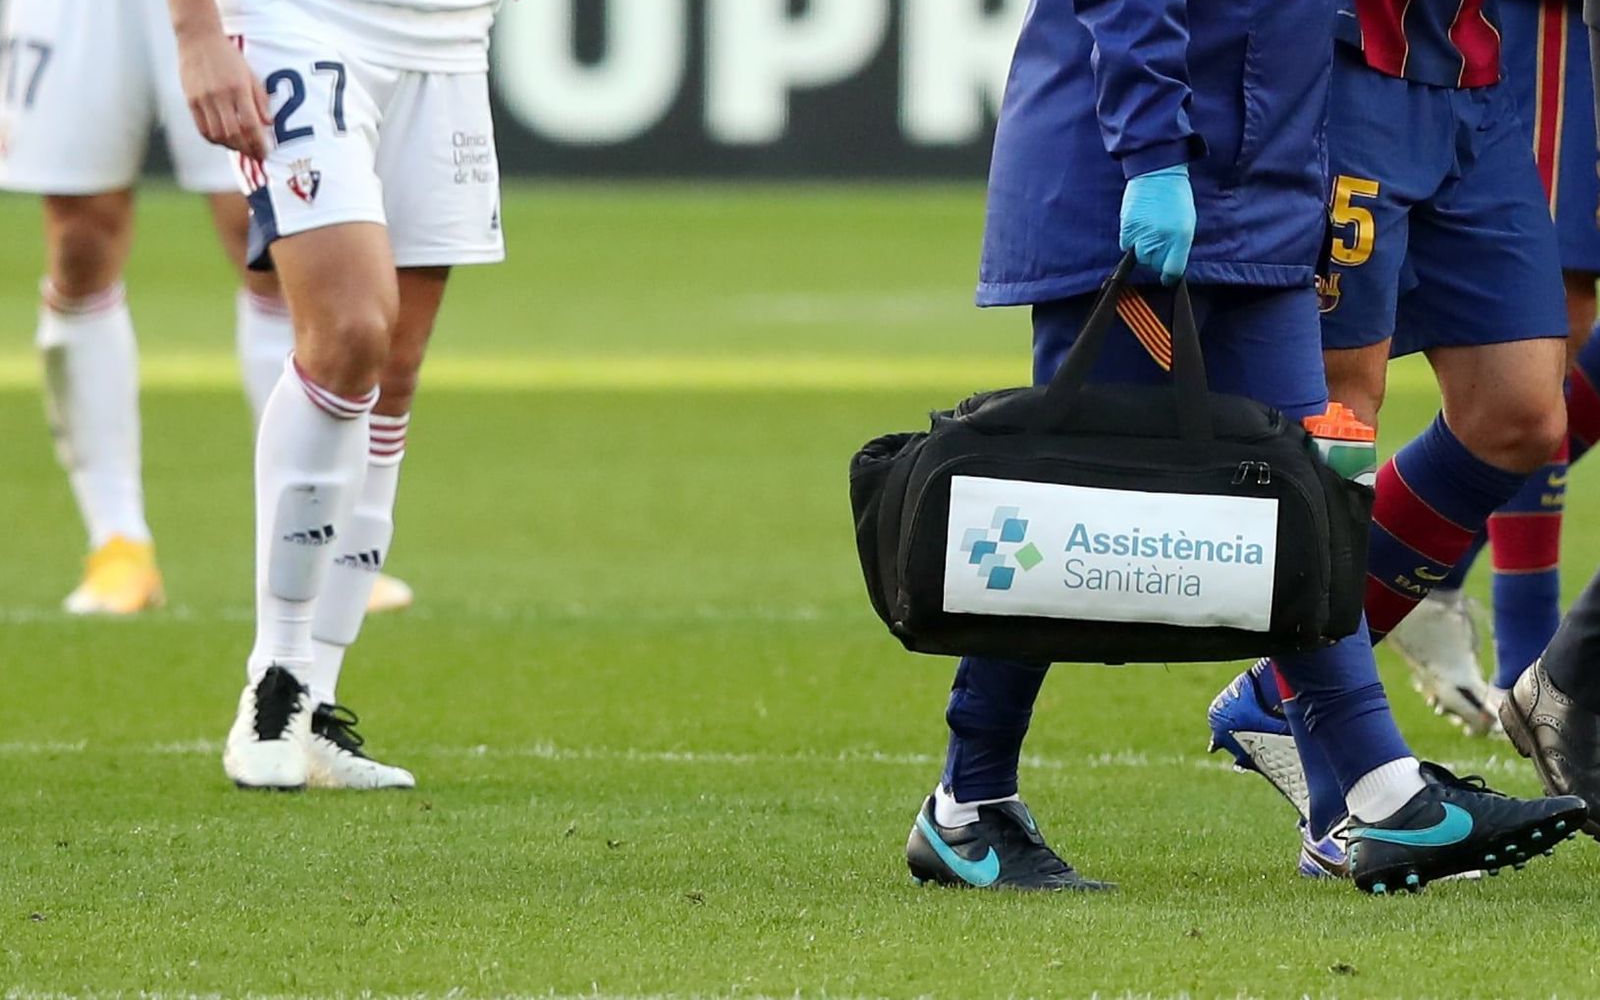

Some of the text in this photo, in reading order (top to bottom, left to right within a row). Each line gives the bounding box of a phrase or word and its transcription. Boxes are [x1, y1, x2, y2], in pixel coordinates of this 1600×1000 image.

[265, 60, 347, 145] 27
[1064, 522, 1264, 565] Assistència
[1063, 557, 1201, 598] Sanitària
